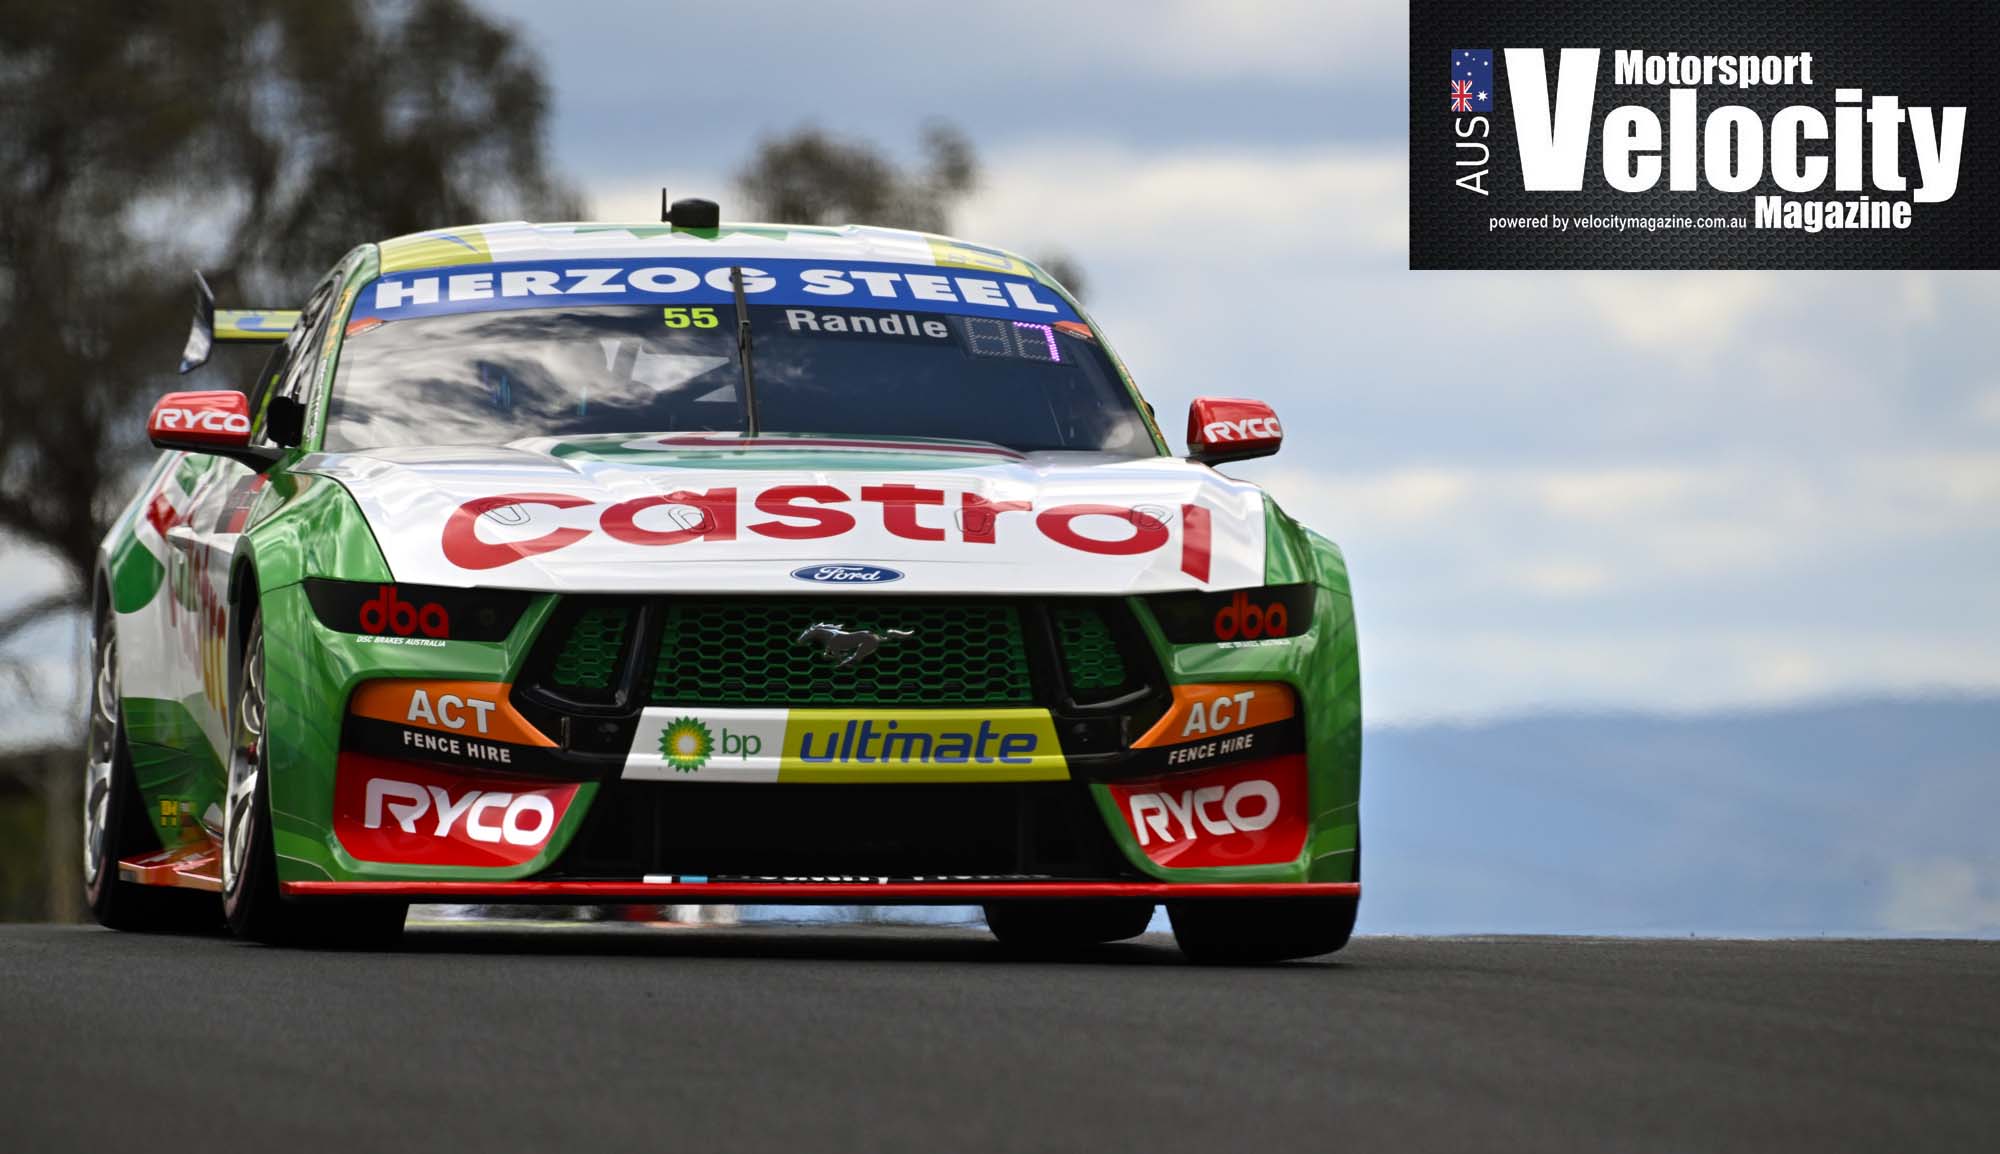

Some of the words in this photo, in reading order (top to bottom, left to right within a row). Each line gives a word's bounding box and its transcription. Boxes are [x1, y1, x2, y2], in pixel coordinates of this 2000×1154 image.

[375, 266, 777, 310] HERZOG
[800, 268, 1059, 314] STEEL
[663, 307, 720, 330] 55
[785, 308, 950, 339] Randle
[154, 407, 250, 433] RYCO
[813, 565, 881, 581] Ford
[359, 585, 449, 638] dba
[1214, 591, 1288, 640] dba
[404, 638, 447, 648] AUSTRALIA
[407, 688, 496, 734] ACT
[1181, 690, 1256, 737] ACT
[403, 730, 461, 755] FENCE
[467, 742, 512, 764] HIRE
[721, 727, 762, 762] bp
[800, 719, 1038, 765] ultimate
[1168, 741, 1216, 766] FENCE
[1220, 733, 1254, 756] HIRE
[363, 777, 555, 847] RYCO
[1129, 779, 1281, 846] RYCO
